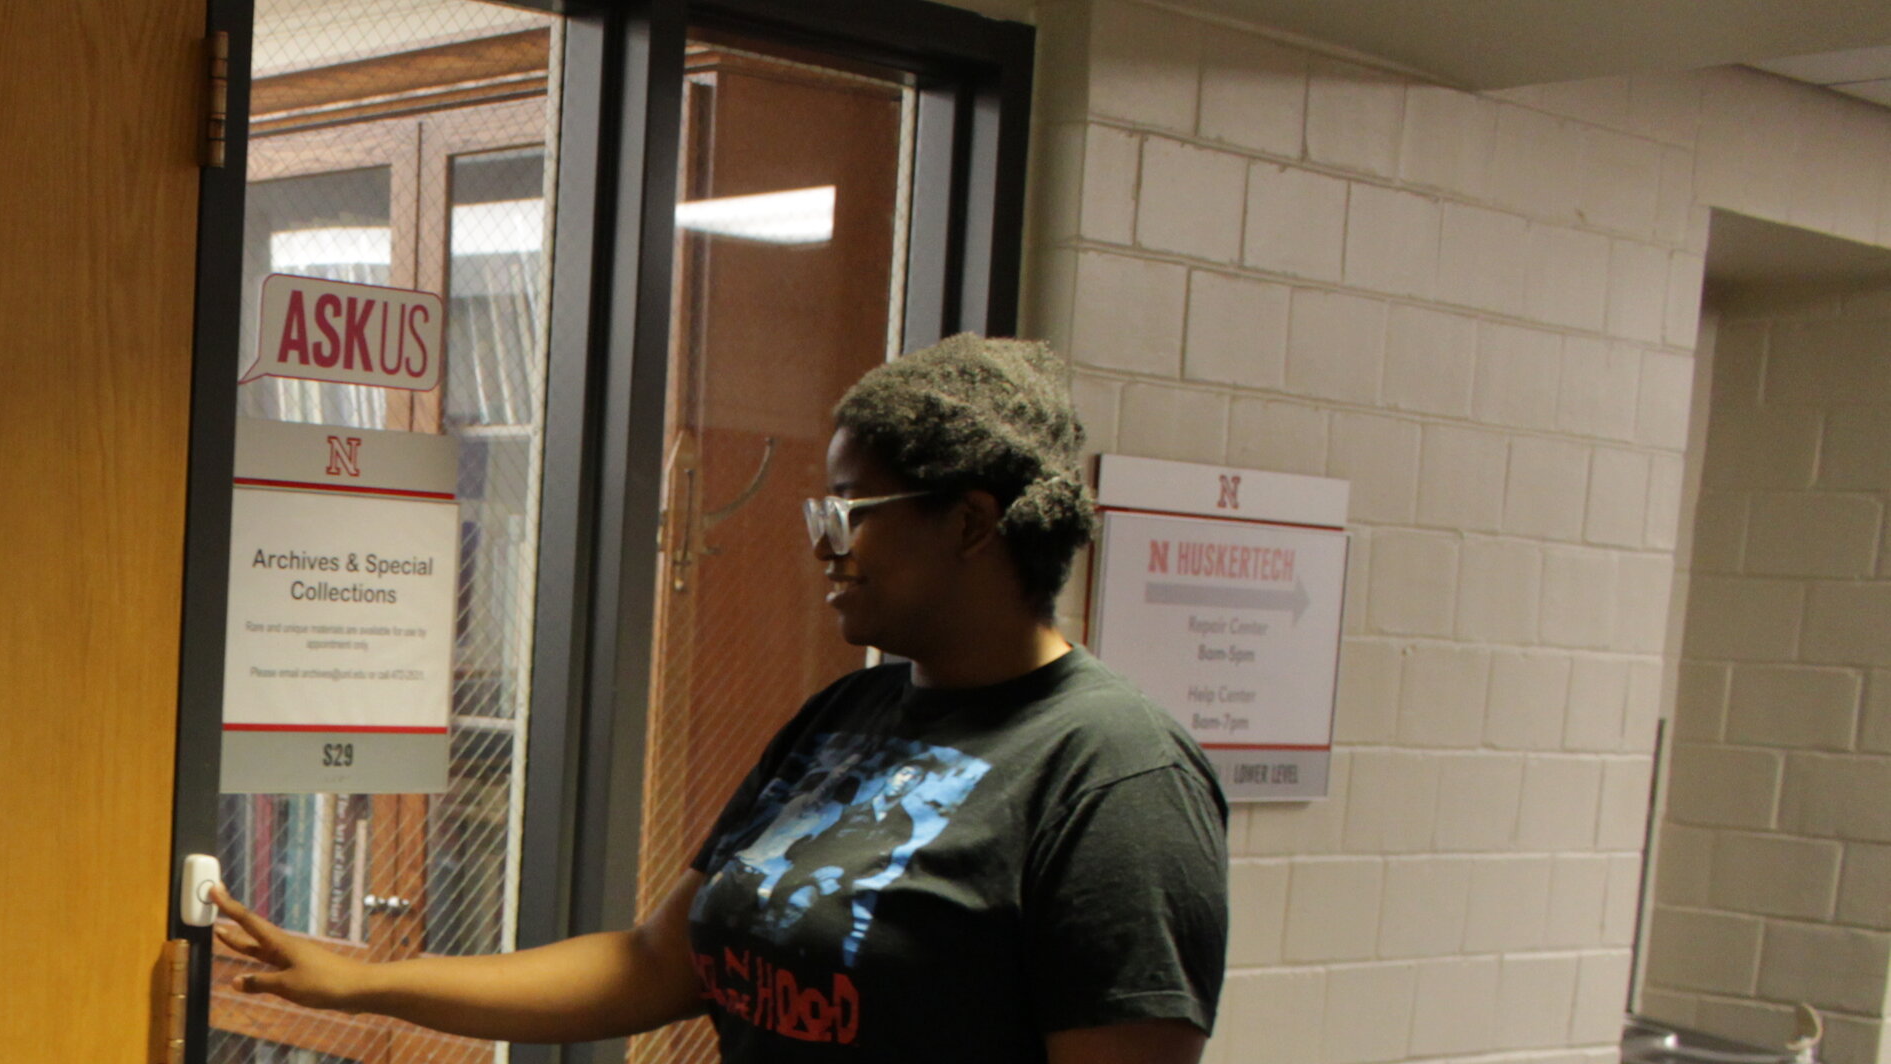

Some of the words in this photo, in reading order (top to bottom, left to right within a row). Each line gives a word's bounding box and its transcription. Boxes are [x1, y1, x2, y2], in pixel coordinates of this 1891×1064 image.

[252, 548, 340, 573] Archives
[345, 552, 360, 573] &
[365, 553, 434, 579] Special
[1176, 541, 1297, 582] HUSKERTECH
[290, 580, 397, 604] Collections
[1229, 617, 1269, 636] Center
[1218, 685, 1257, 703] Center
[322, 743, 354, 767] S29
[1271, 764, 1299, 784] LEVEL
